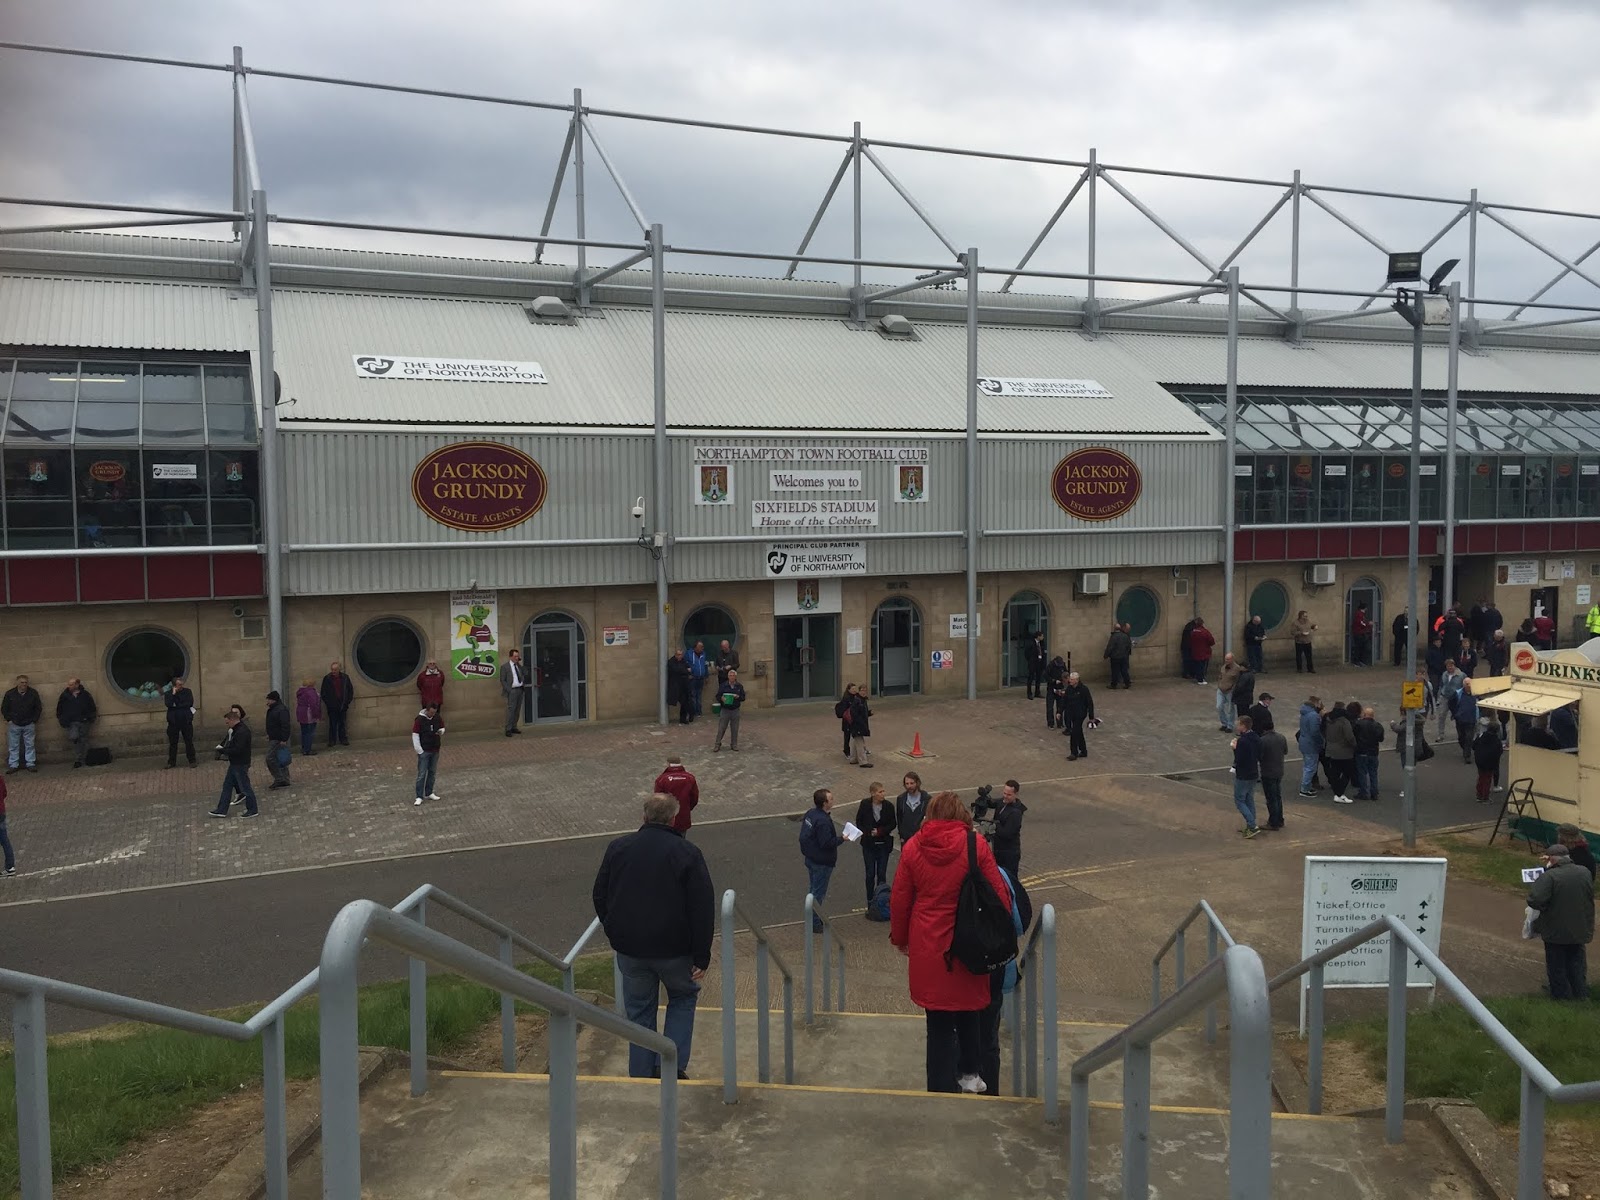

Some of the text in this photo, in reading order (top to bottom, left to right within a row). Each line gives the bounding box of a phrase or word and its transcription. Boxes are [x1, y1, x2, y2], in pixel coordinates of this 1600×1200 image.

[401, 361, 518, 372] THE UNIVERSITY
[404, 368, 545, 380] OF NORTHAMPTON
[1028, 382, 1086, 390] UNIVERSITY
[1028, 388, 1109, 396] NORTHAMPTON
[697, 447, 928, 460] NORTHAMPTON TOWN FOOTBALL CLUB
[432, 462, 528, 481] JACKSON
[1065, 465, 1129, 480] JACKSON
[773, 474, 859, 489] Welcomes you to
[433, 483, 526, 500] GRUNDY
[1065, 481, 1128, 495] GRUNDY
[754, 502, 876, 514] SIXFIELDS STADIUM
[1070, 500, 1125, 514] ESTATE AGENTS
[440, 505, 522, 523] ESTATE AGENTS
[760, 515, 872, 527] Home of the Cobblers
[808, 554, 853, 562] UNIVERSITY
[803, 563, 865, 572] NORTHAMPTON
[1364, 879, 1397, 890] SIXFIELDS
[1316, 901, 1386, 909] Ticket Office
[1316, 913, 1367, 921] Turnstiles
[1314, 938, 1328, 946] All
